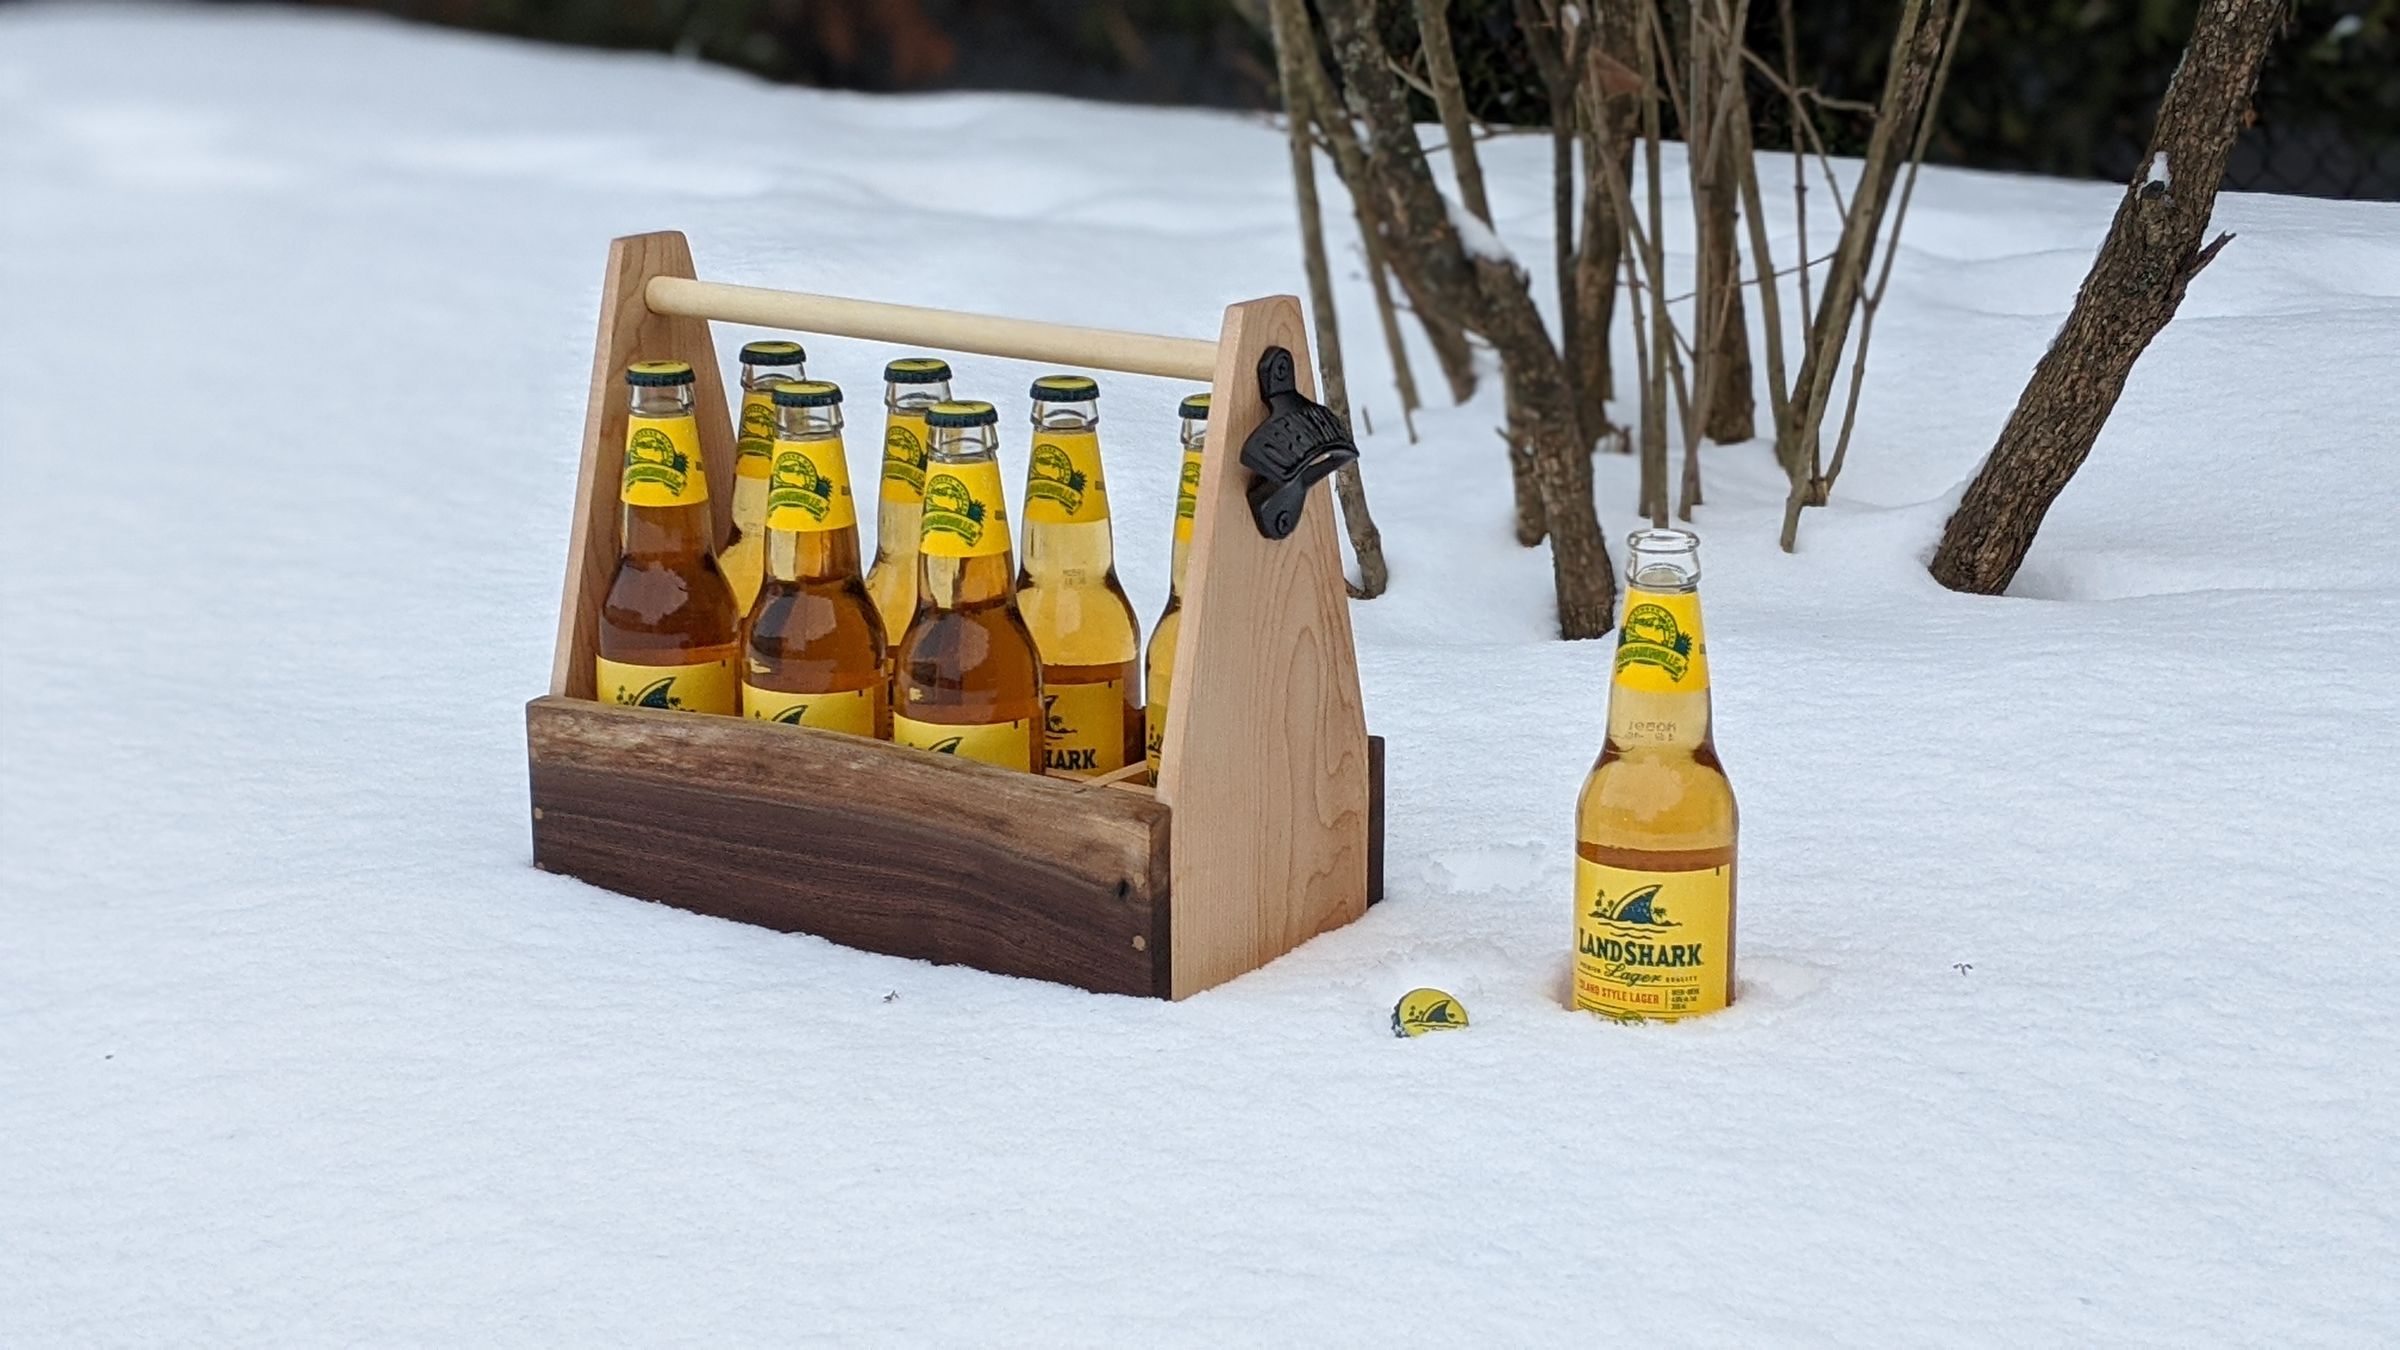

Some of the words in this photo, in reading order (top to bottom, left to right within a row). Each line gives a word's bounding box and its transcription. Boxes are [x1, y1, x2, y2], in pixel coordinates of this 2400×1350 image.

[1578, 927, 1704, 967] LANDSHARK
[1603, 962, 1663, 987] Lager
[1601, 987, 1628, 1001] STYLE
[1629, 992, 1660, 1004] LAGER
